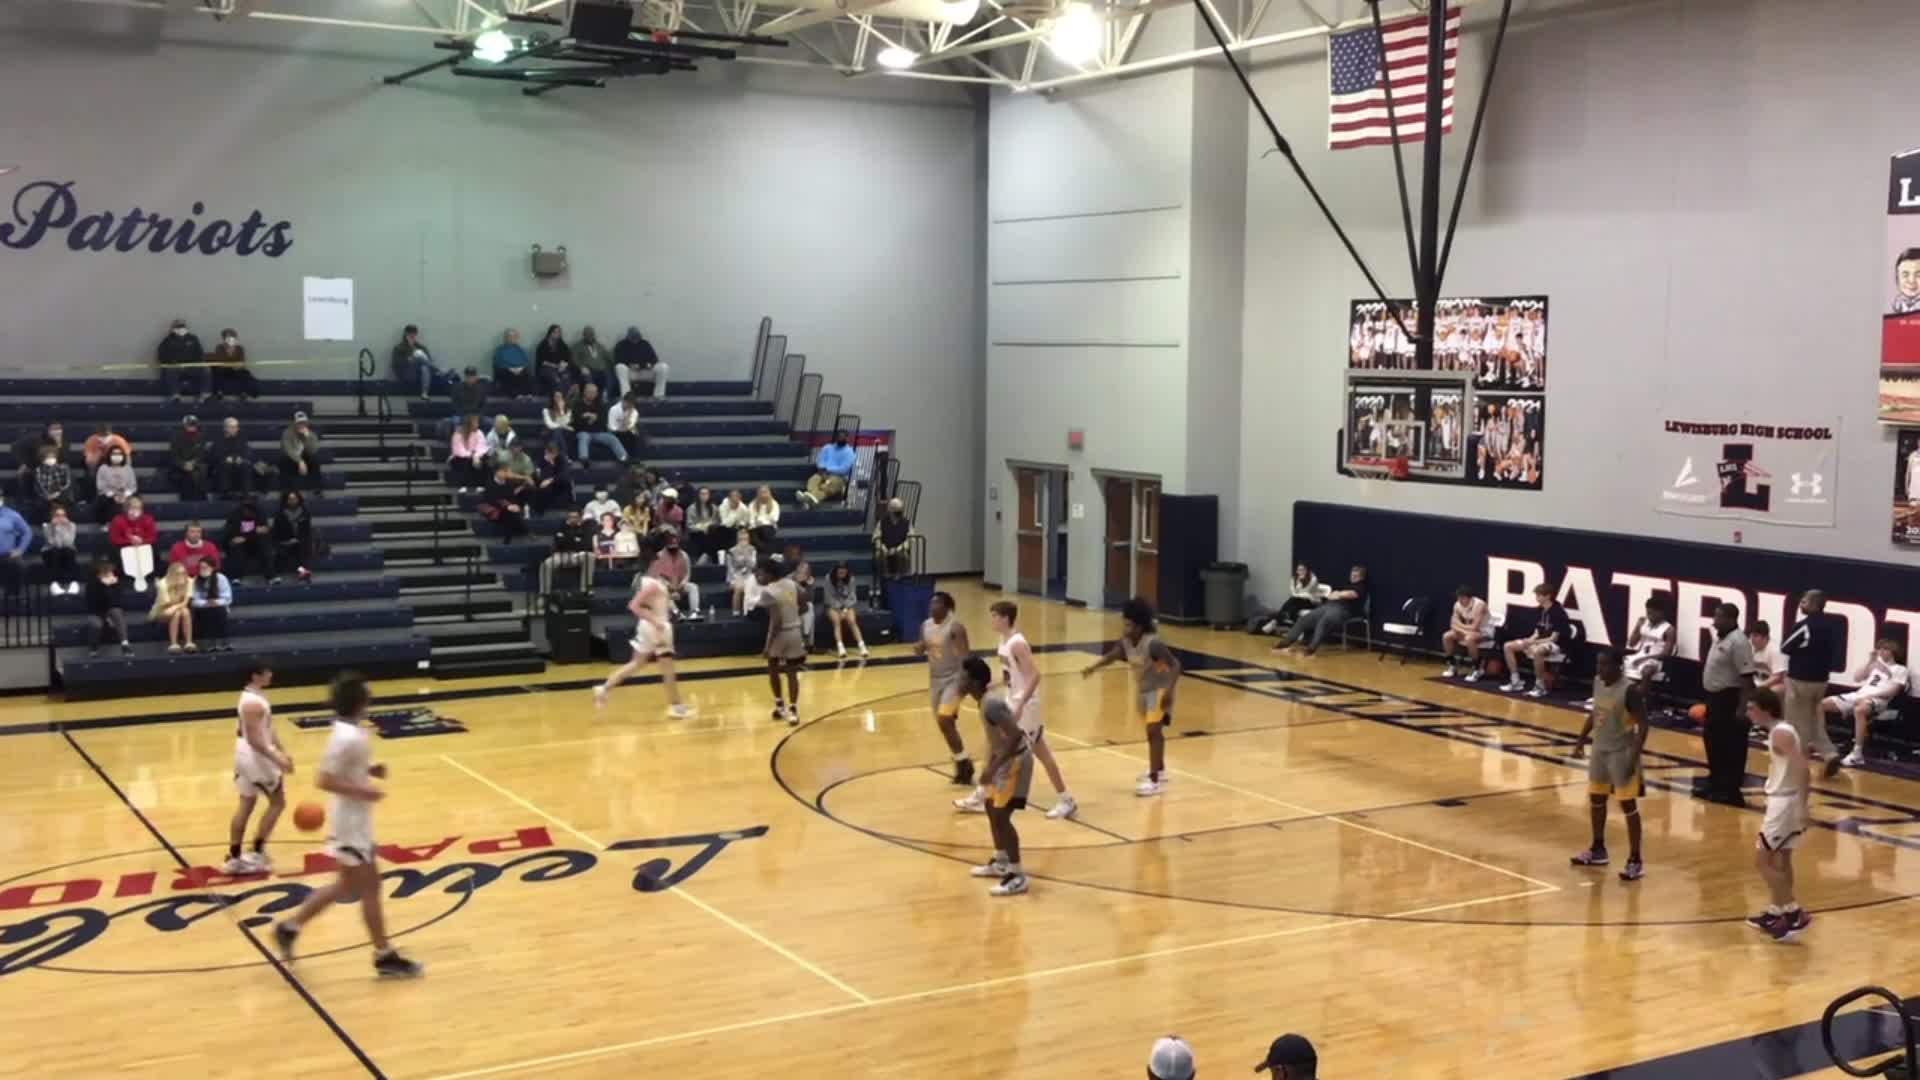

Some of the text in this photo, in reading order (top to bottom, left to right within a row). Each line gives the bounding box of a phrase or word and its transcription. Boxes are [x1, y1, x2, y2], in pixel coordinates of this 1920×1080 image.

[0, 180, 293, 257] Patriots
[1664, 420, 1833, 441] LEWISBURG HIGH SCHOOL
